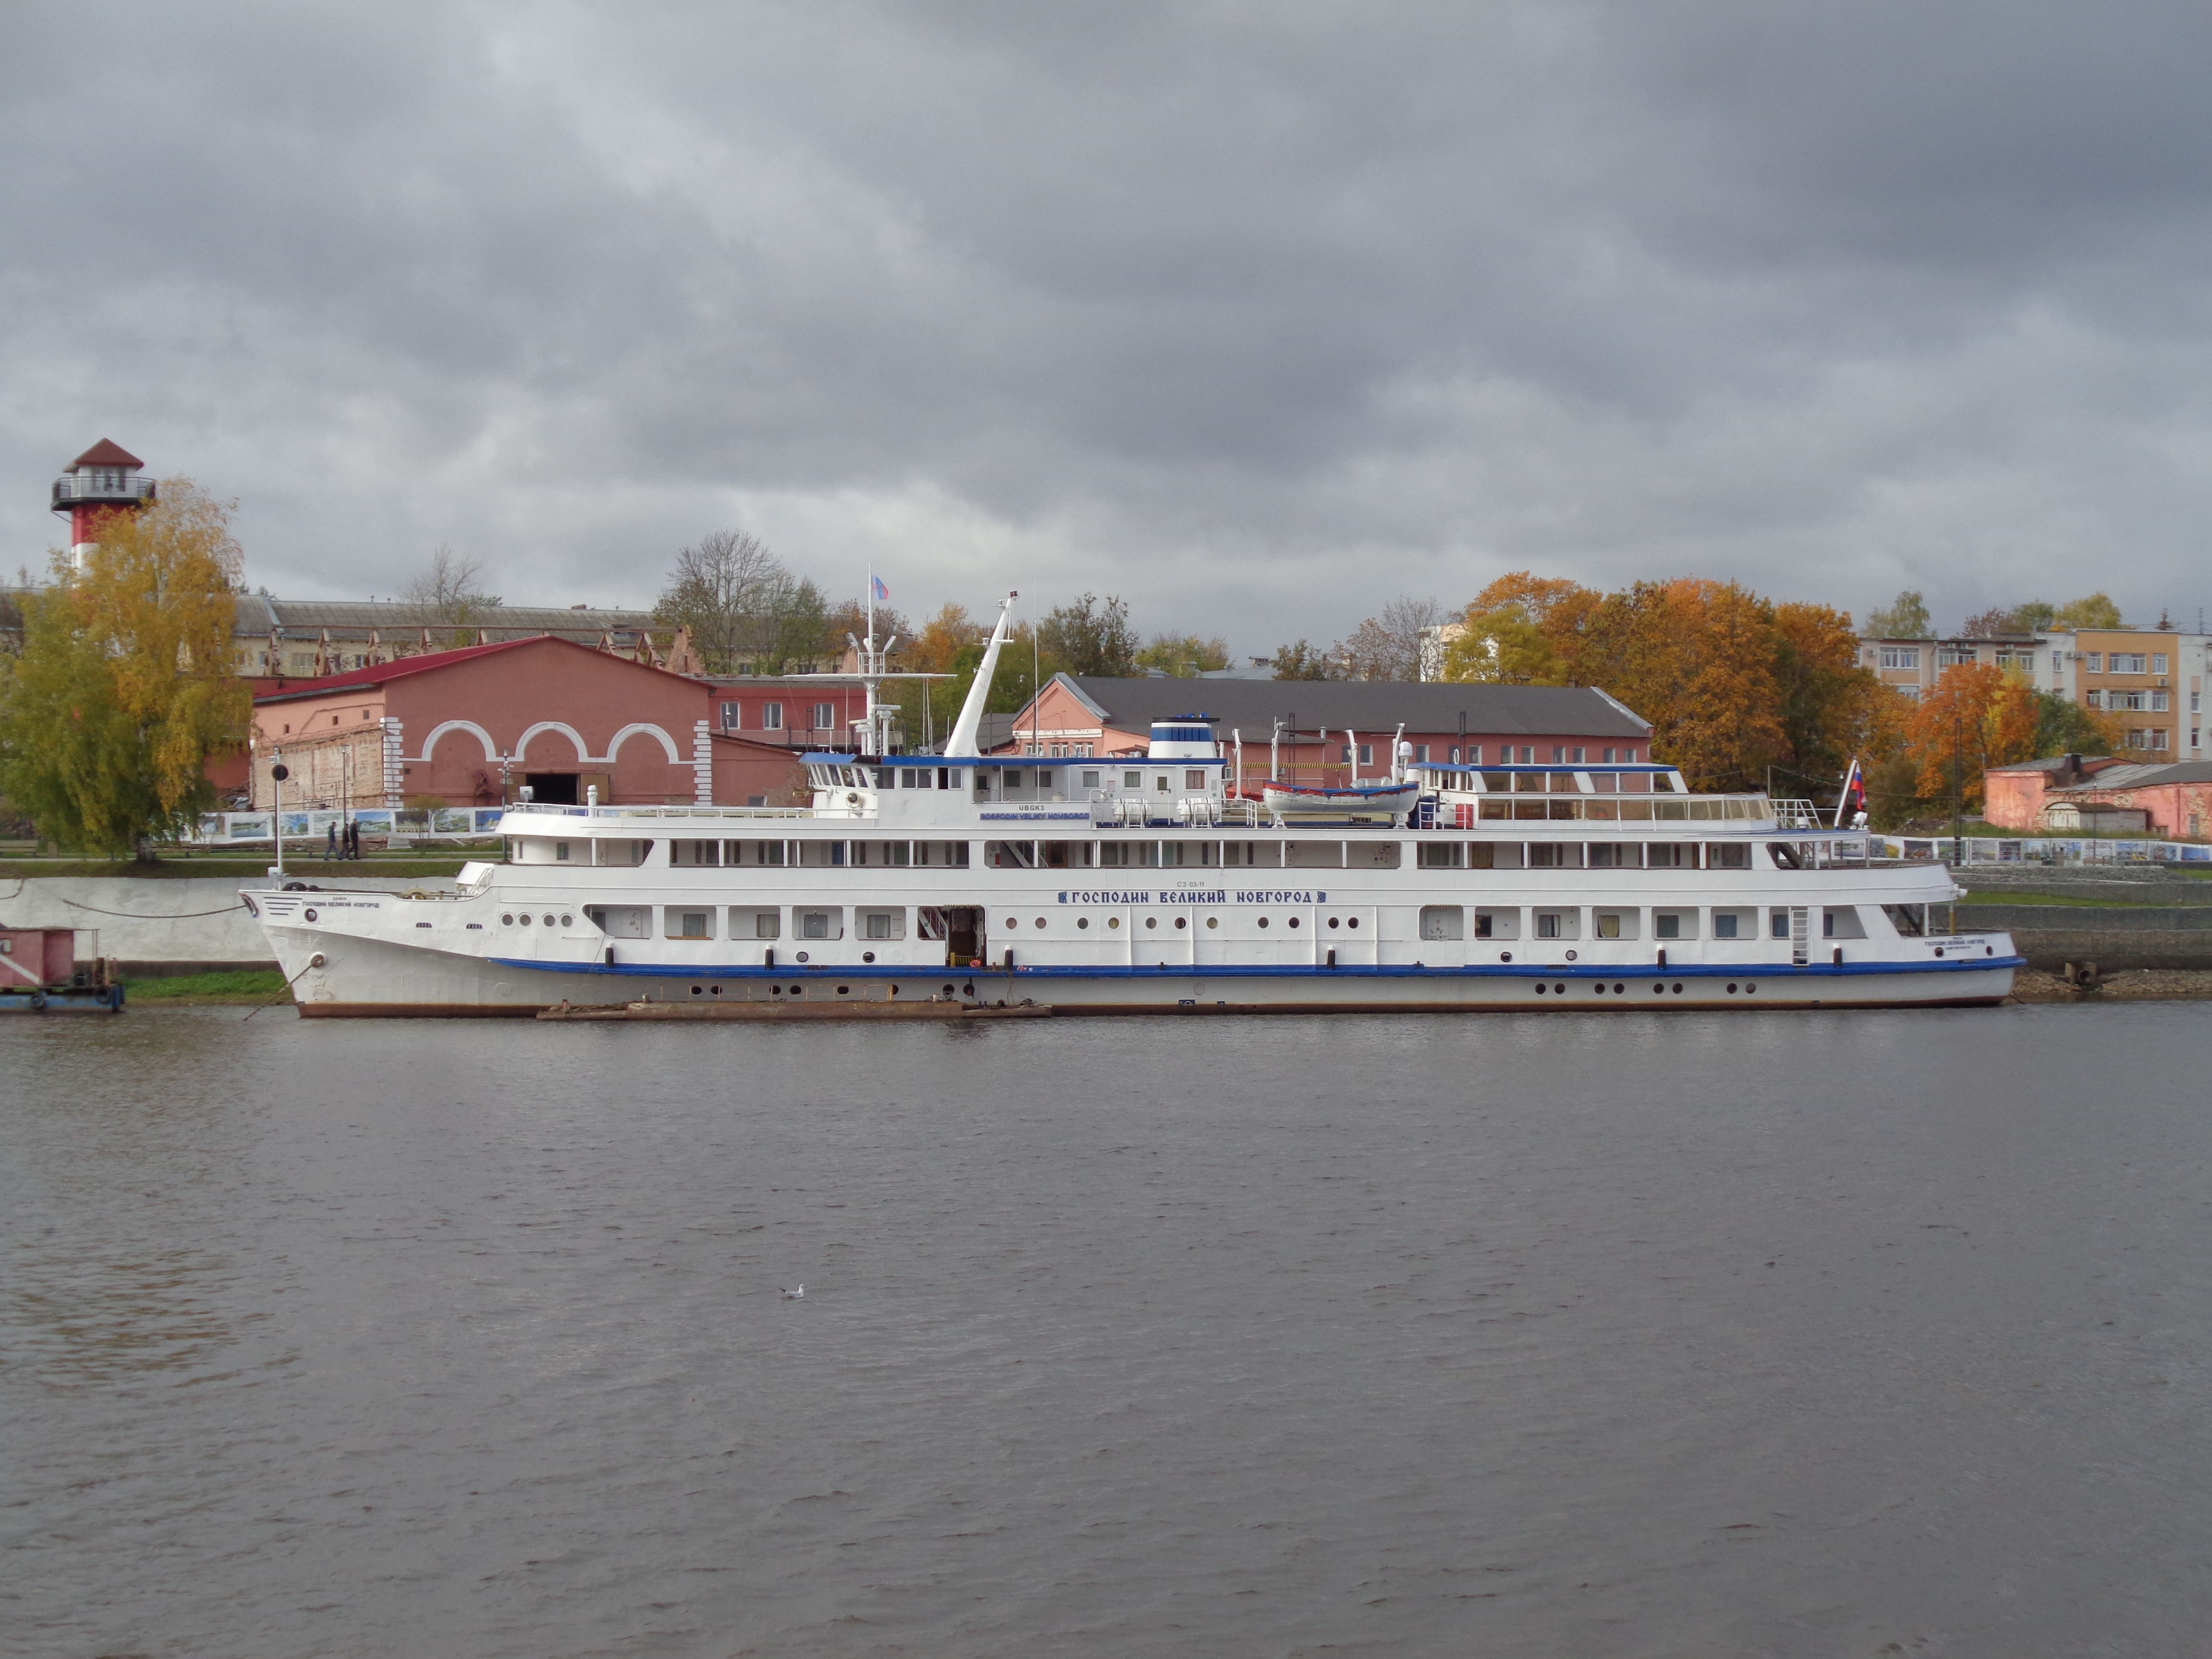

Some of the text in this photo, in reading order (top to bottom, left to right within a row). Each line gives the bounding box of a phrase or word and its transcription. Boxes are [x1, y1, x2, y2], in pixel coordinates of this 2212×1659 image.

[1072, 890, 1312, 903] ГОСПОДИН ВЕЛИКИЙ НОВГОРОД
